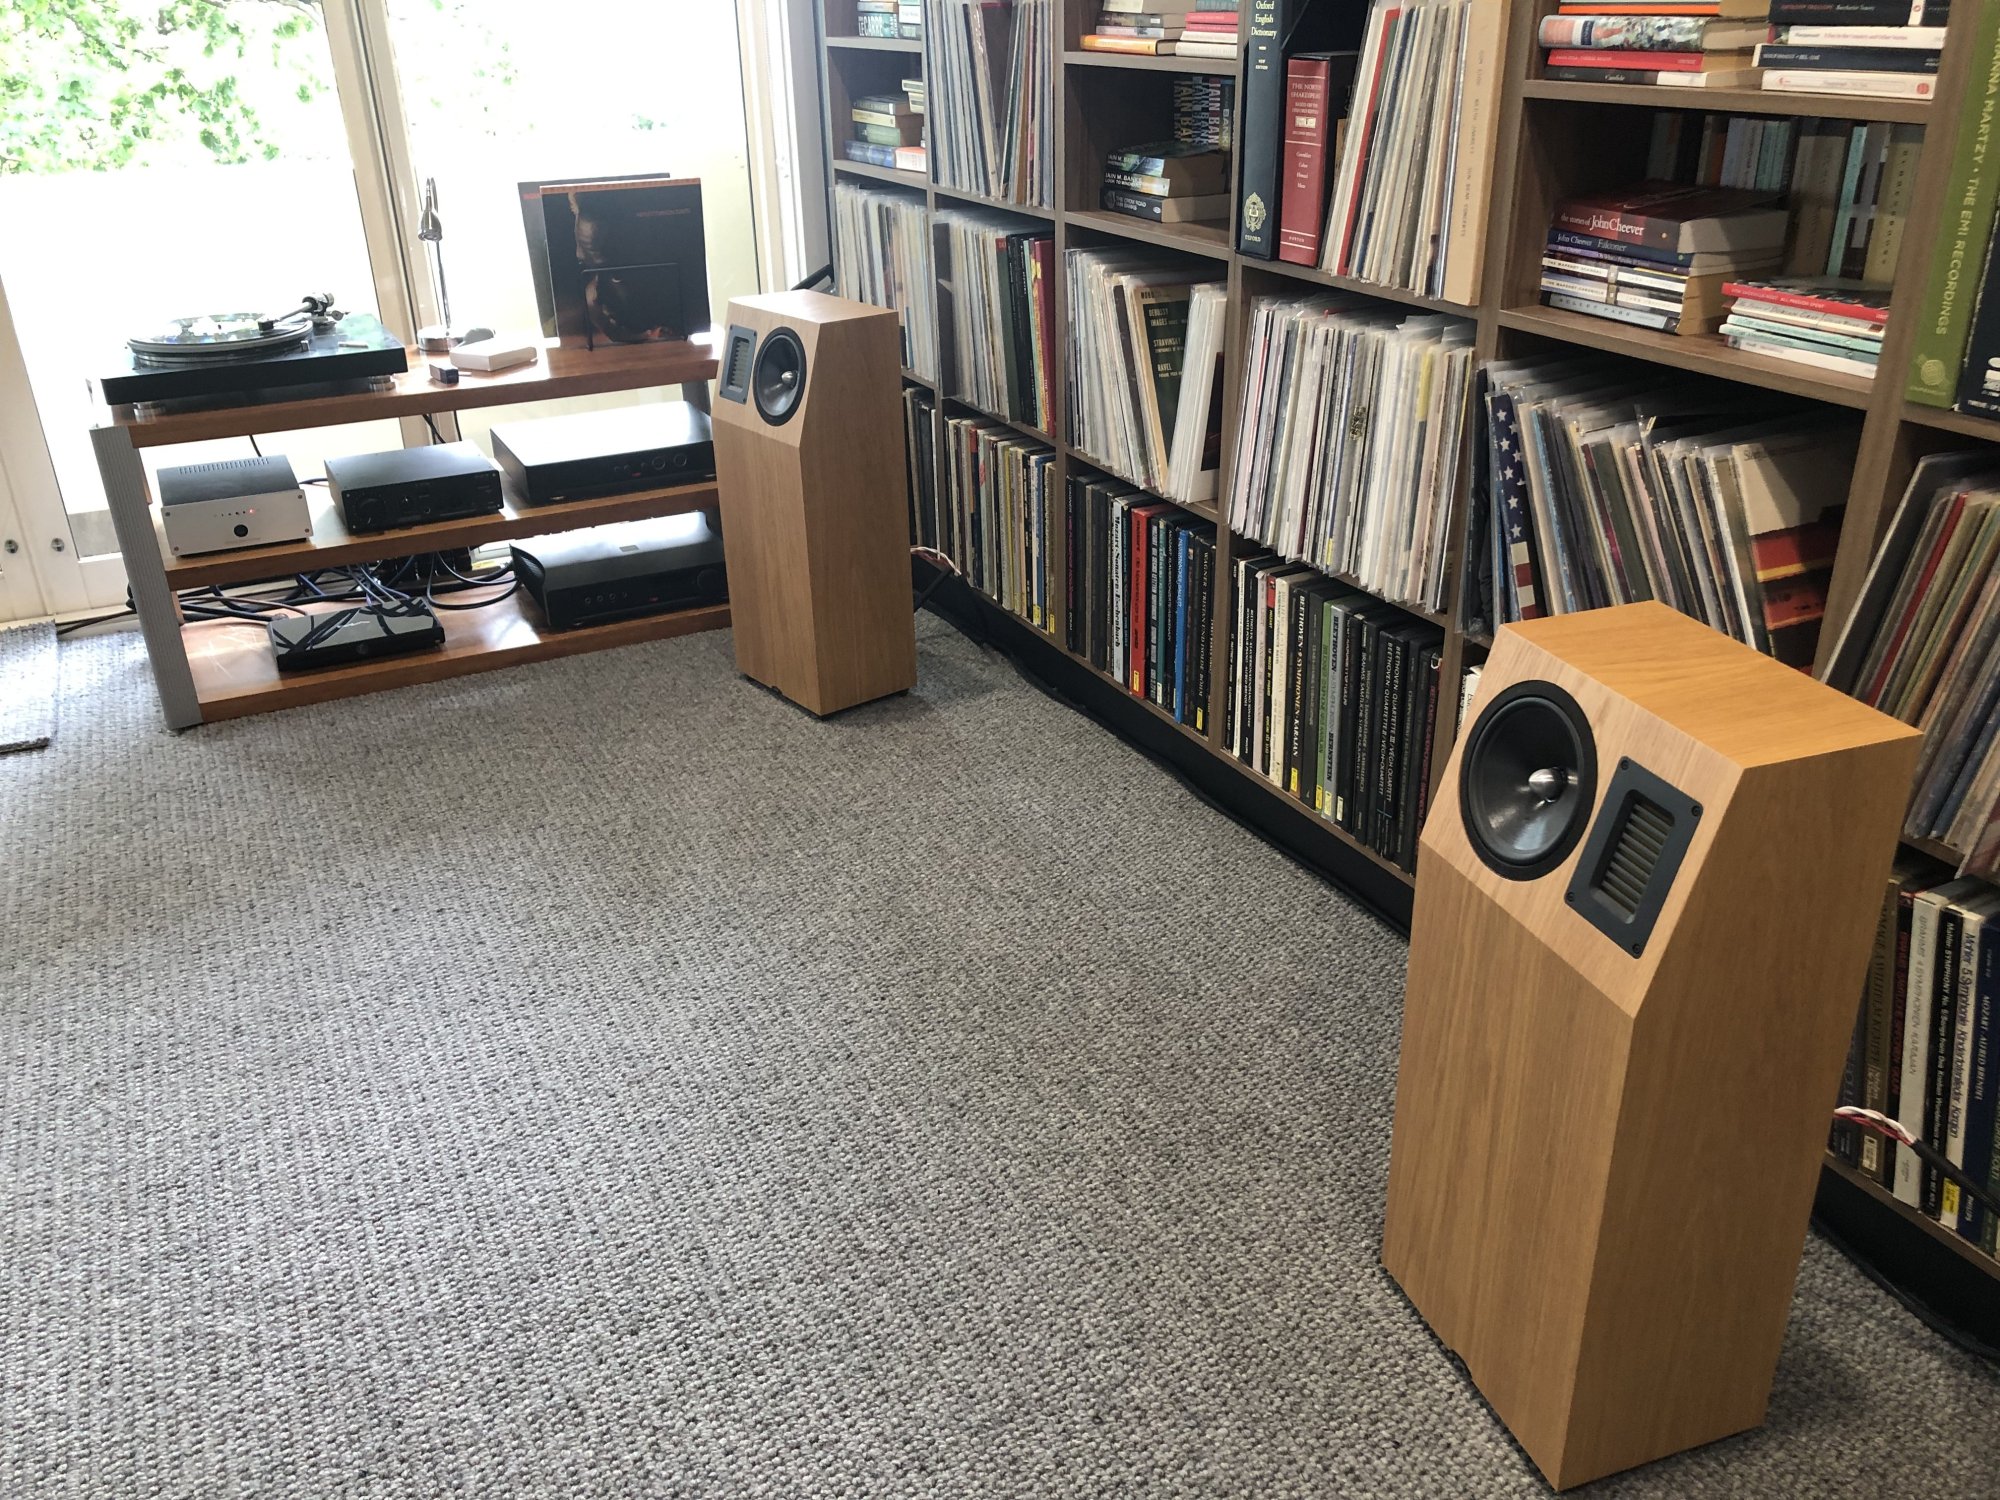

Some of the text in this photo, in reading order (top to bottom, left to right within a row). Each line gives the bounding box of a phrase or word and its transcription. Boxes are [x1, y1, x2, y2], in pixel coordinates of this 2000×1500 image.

[1255, 14, 1274, 26] English
[1256, 0, 1274, 10] Oxford
[1251, 26, 1278, 40] Dictionary
[1972, 100, 1995, 164] MARTZY
[1106, 172, 1116, 180] IAIN
[1963, 178, 1980, 206] THE
[1556, 233, 1570, 243] John
[1570, 237, 1592, 247] Cheever
[1958, 210, 1973, 236] EMI
[1936, 240, 1967, 336] RECORDINGS
[1148, 308, 1168, 316] DEBUSSY
[1150, 318, 1168, 326] IMAGES
[1153, 337, 1180, 347] STRAVINSKY
[1157, 362, 1172, 372] RAVEL
[1297, 595, 1306, 647] BEETHOVEN
[1331, 615, 1339, 672] BEETHOVEN
[1294, 657, 1303, 715] SYMPHONIEN
[1382, 641, 1393, 730] BEETHOVEN QUARTETTE
[1293, 717, 1301, 757] KARAJAN
[1386, 645, 1402, 802] BEETHOVEN QUARTETTE QUARTETT
[1327, 730, 1335, 782] BERNSTEIN
[1915, 915, 1928, 957] BRAHMS
[1944, 921, 1956, 947] Mahler
[1962, 932, 1977, 963] Mahler
[1871, 961, 1886, 1016] WILHELM
[1941, 949, 1954, 994] SYMPHONY
[1912, 966, 1926, 1028] SYMPHONIEN
[1956, 975, 1974, 1027] Symphonie
[1909, 1031, 1922, 1075] KARAJAN
[1951, 1028, 1969, 1104] Kindertotenlieder
[1948, 1104, 1963, 1139] Karajan
[1963, 993, 1993, 1222] MOZART ALFRED BRENDEL PHILIPS
